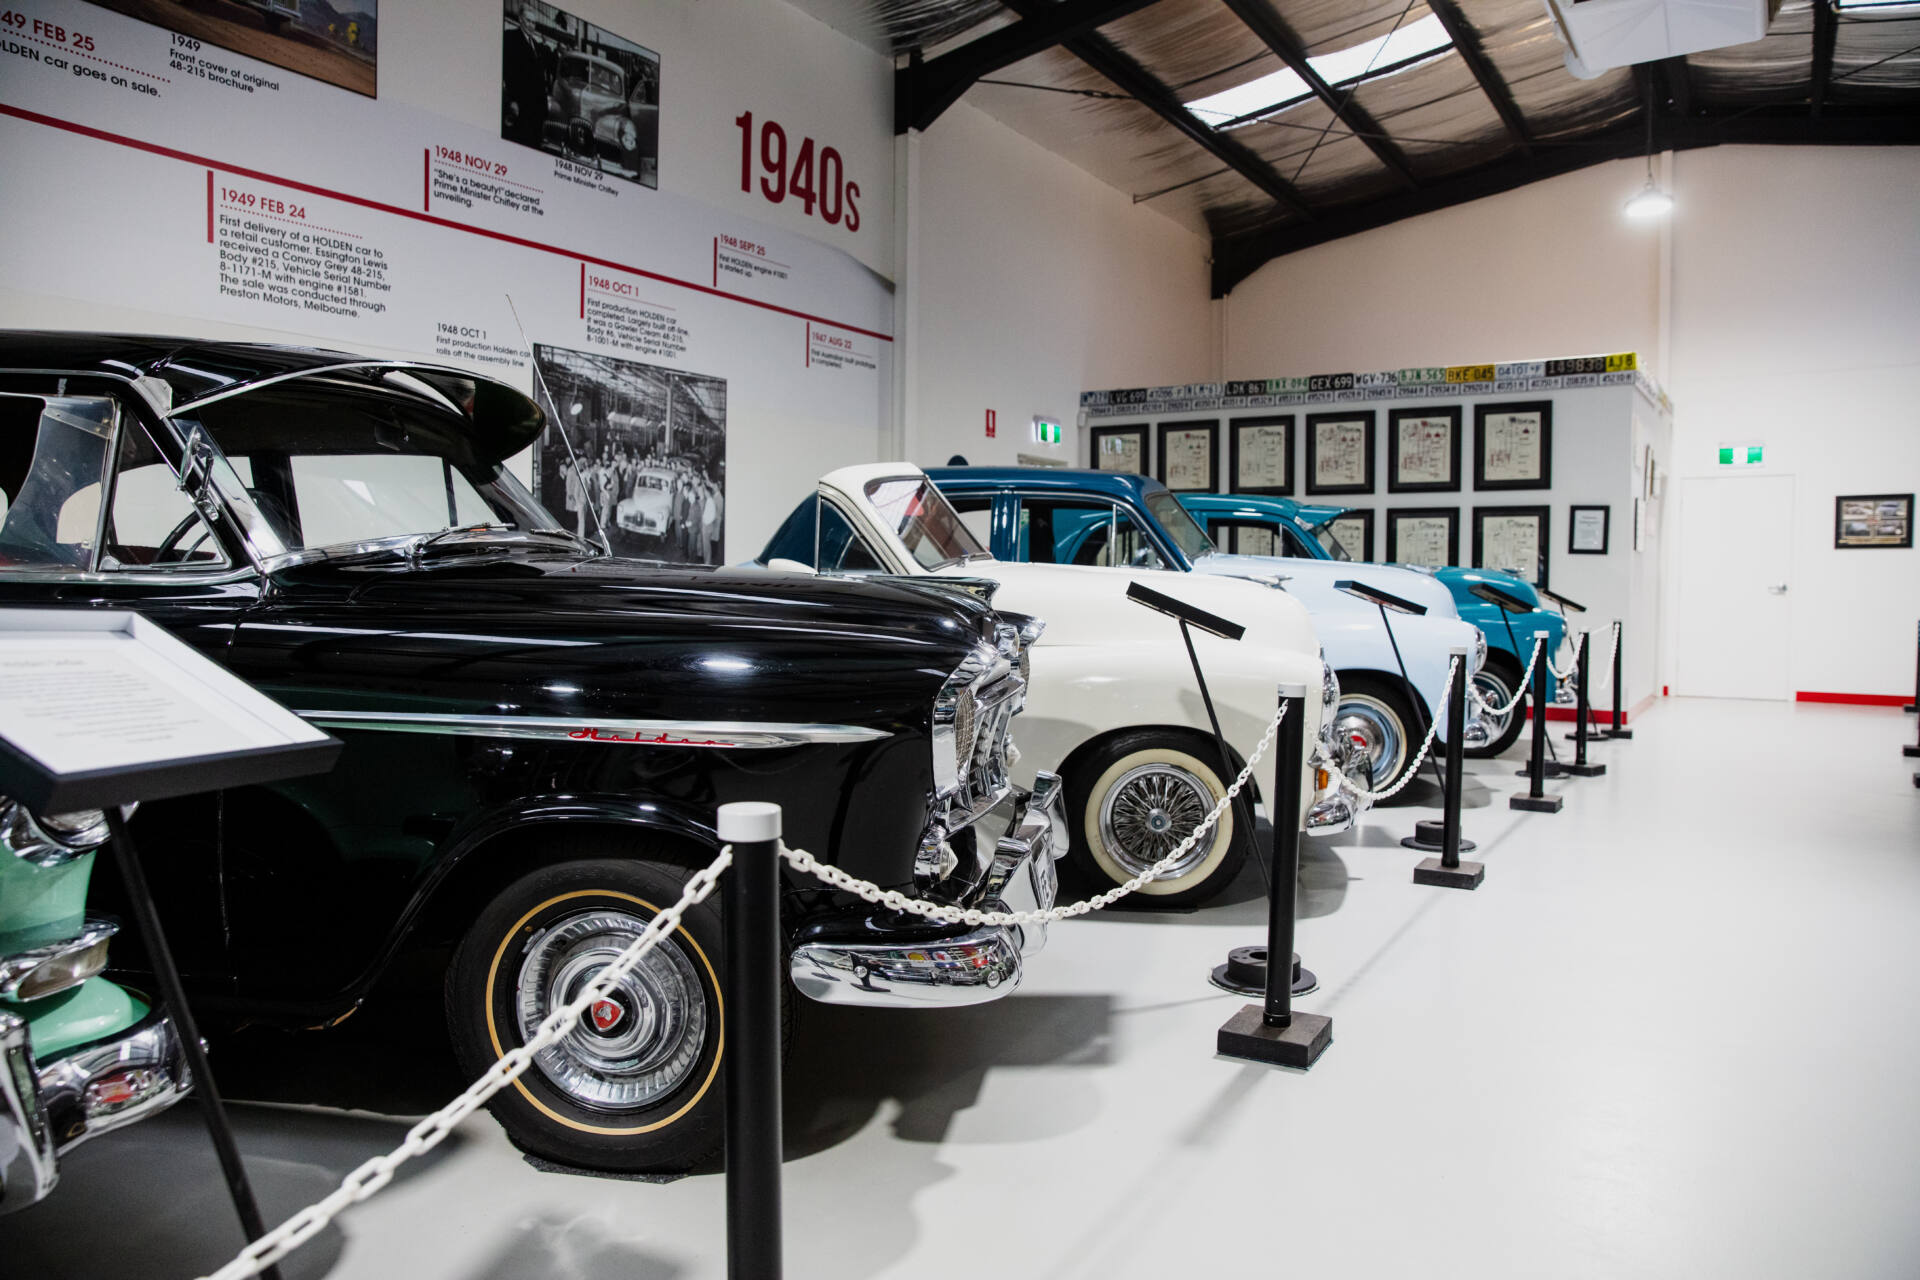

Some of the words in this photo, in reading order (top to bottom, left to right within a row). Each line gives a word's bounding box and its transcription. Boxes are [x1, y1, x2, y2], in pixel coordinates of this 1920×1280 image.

[0, 11, 26, 28] 49
[33, 19, 66, 42] FEB
[73, 33, 95, 51] 25
[172, 33, 200, 51] 1949
[0, 40, 39, 61] LDEN
[44, 55, 69, 69] car
[73, 64, 106, 81] goes
[111, 75, 127, 87] on
[132, 82, 161, 97] sale.
[170, 49, 195, 64] Front
[199, 60, 228, 74] cover
[231, 70, 240, 78] of
[243, 74, 279, 91] original
[170, 61, 205, 78] 48-215
[209, 72, 253, 93] brochure
[436, 145, 461, 163] 1948
[465, 154, 491, 171] NOV
[495, 164, 507, 176] 29
[555, 159, 572, 171] 1948
[575, 166, 592, 177] NOV
[736, 110, 860, 232] 1940s
[555, 171, 571, 181] Prime
[574, 176, 596, 188] Minister
[222, 188, 255, 206] 1949
[261, 197, 284, 214] FEB
[289, 205, 305, 219] 24
[434, 179, 457, 192] Prime
[461, 186, 491, 201] Minister
[494, 195, 520, 210] Chifley
[532, 206, 544, 215] the
[505, 189, 540, 205] declared
[220, 215, 240, 227] First
[244, 220, 286, 239] delivery
[290, 232, 300, 241] of
[313, 236, 352, 252] HOLDEN
[355, 246, 371, 256] car
[374, 249, 383, 258] to
[231, 229, 257, 243] retail
[261, 236, 312, 255] customer.
[316, 247, 360, 266] Essington
[363, 257, 387, 270] Lewis
[740, 240, 755, 252] SEPT
[220, 240, 268, 256] received
[282, 252, 321, 268] Convoy
[325, 261, 347, 273] Grey
[220, 250, 247, 265] Body
[283, 263, 321, 278] Vehicle
[324, 271, 350, 284] Serial
[354, 275, 391, 291] Number
[275, 272, 296, 284] with
[300, 280, 333, 295] engine
[220, 274, 238, 285] The
[243, 277, 264, 289] sale
[268, 284, 288, 294] was
[292, 288, 346, 305] conducted
[350, 298, 386, 312] through
[589, 276, 609, 290] 1948
[613, 282, 632, 295] OCT
[220, 285, 259, 301] Preston
[263, 293, 300, 308] Motors,
[305, 301, 360, 318] Melbourne.
[588, 298, 600, 307] First
[602, 303, 637, 315] production
[640, 311, 664, 321] HOLDEN
[438, 323, 458, 334] 1948
[461, 327, 479, 338] OCT
[483, 331, 486, 339] 1
[628, 317, 650, 328] Largely
[653, 321, 666, 330] built
[640, 328, 660, 338] Cream
[437, 336, 450, 344] First
[452, 340, 491, 351] production
[494, 346, 518, 355] Holden
[587, 325, 604, 335] Body
[619, 332, 641, 342] Vehicle
[644, 337, 660, 346] Serial
[663, 341, 686, 351] Number
[621, 342, 633, 350] with
[635, 346, 657, 354] engine
[464, 351, 475, 359] the
[478, 354, 510, 365] assembly
